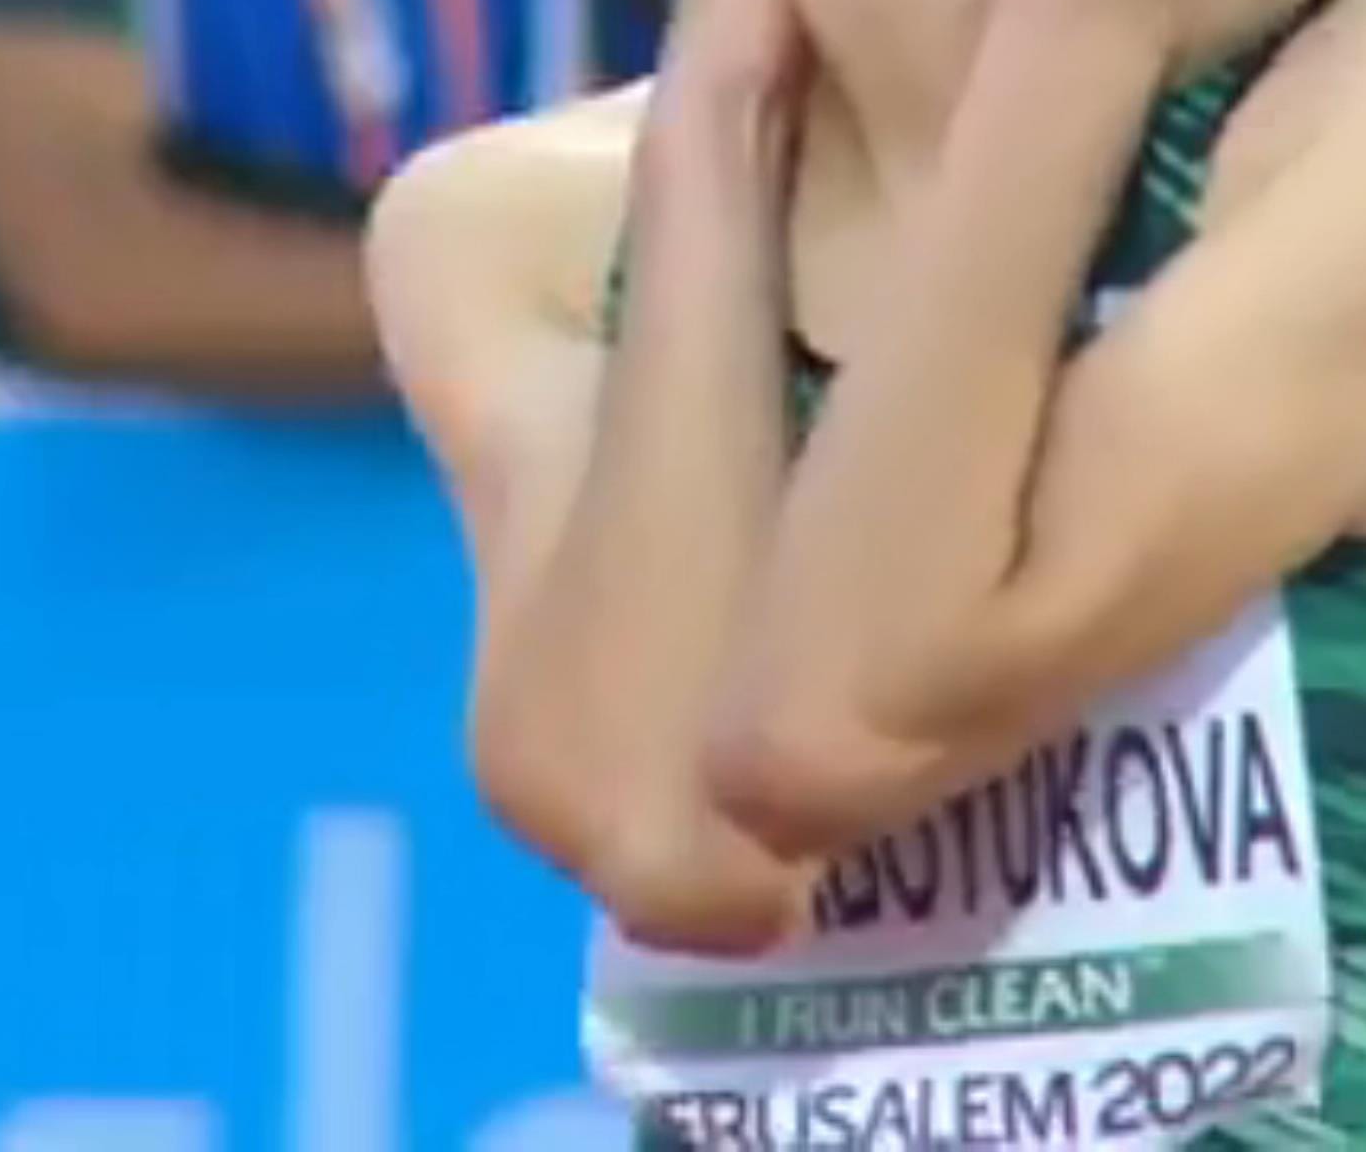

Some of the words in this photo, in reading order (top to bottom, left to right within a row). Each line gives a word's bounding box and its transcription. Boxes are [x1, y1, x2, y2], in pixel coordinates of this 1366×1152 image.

[773, 992, 907, 1045] RUN
[929, 961, 1134, 1038] CLEAN
[1090, 1034, 1297, 1137] 2022
